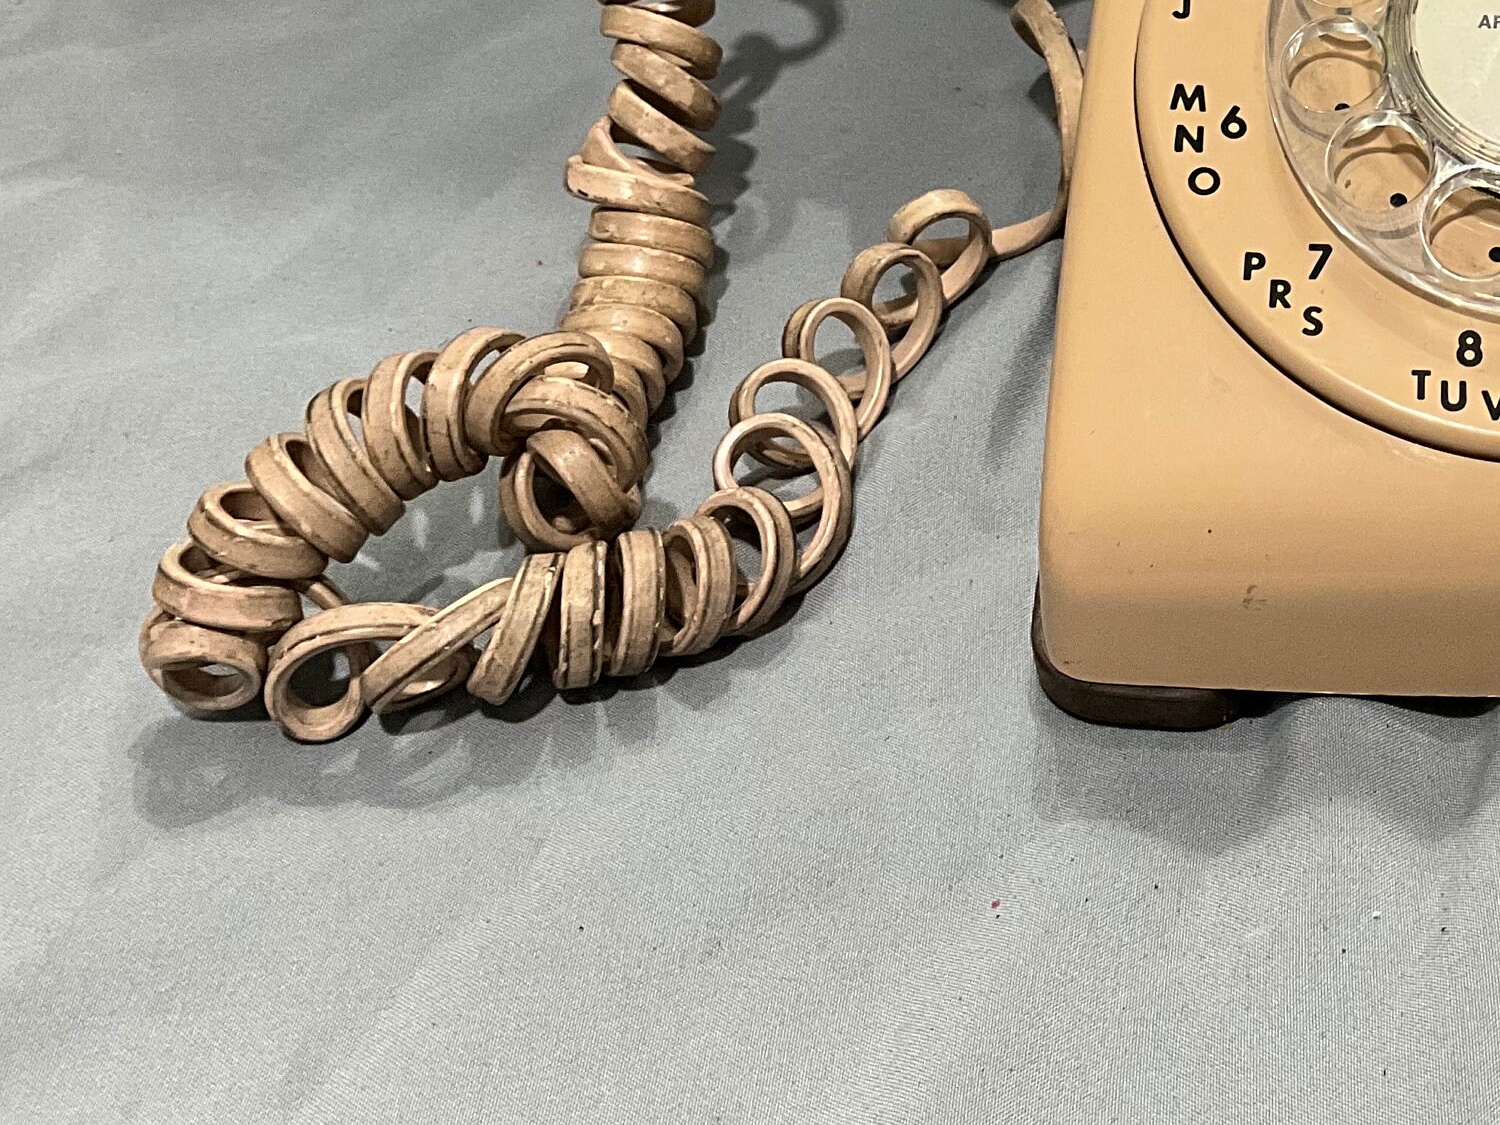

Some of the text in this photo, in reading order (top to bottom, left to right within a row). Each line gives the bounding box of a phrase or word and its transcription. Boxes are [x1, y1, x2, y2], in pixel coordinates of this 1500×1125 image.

[1220, 105, 1248, 140] 6
[1308, 243, 1333, 280] 7
[1456, 329, 1483, 368] 8
